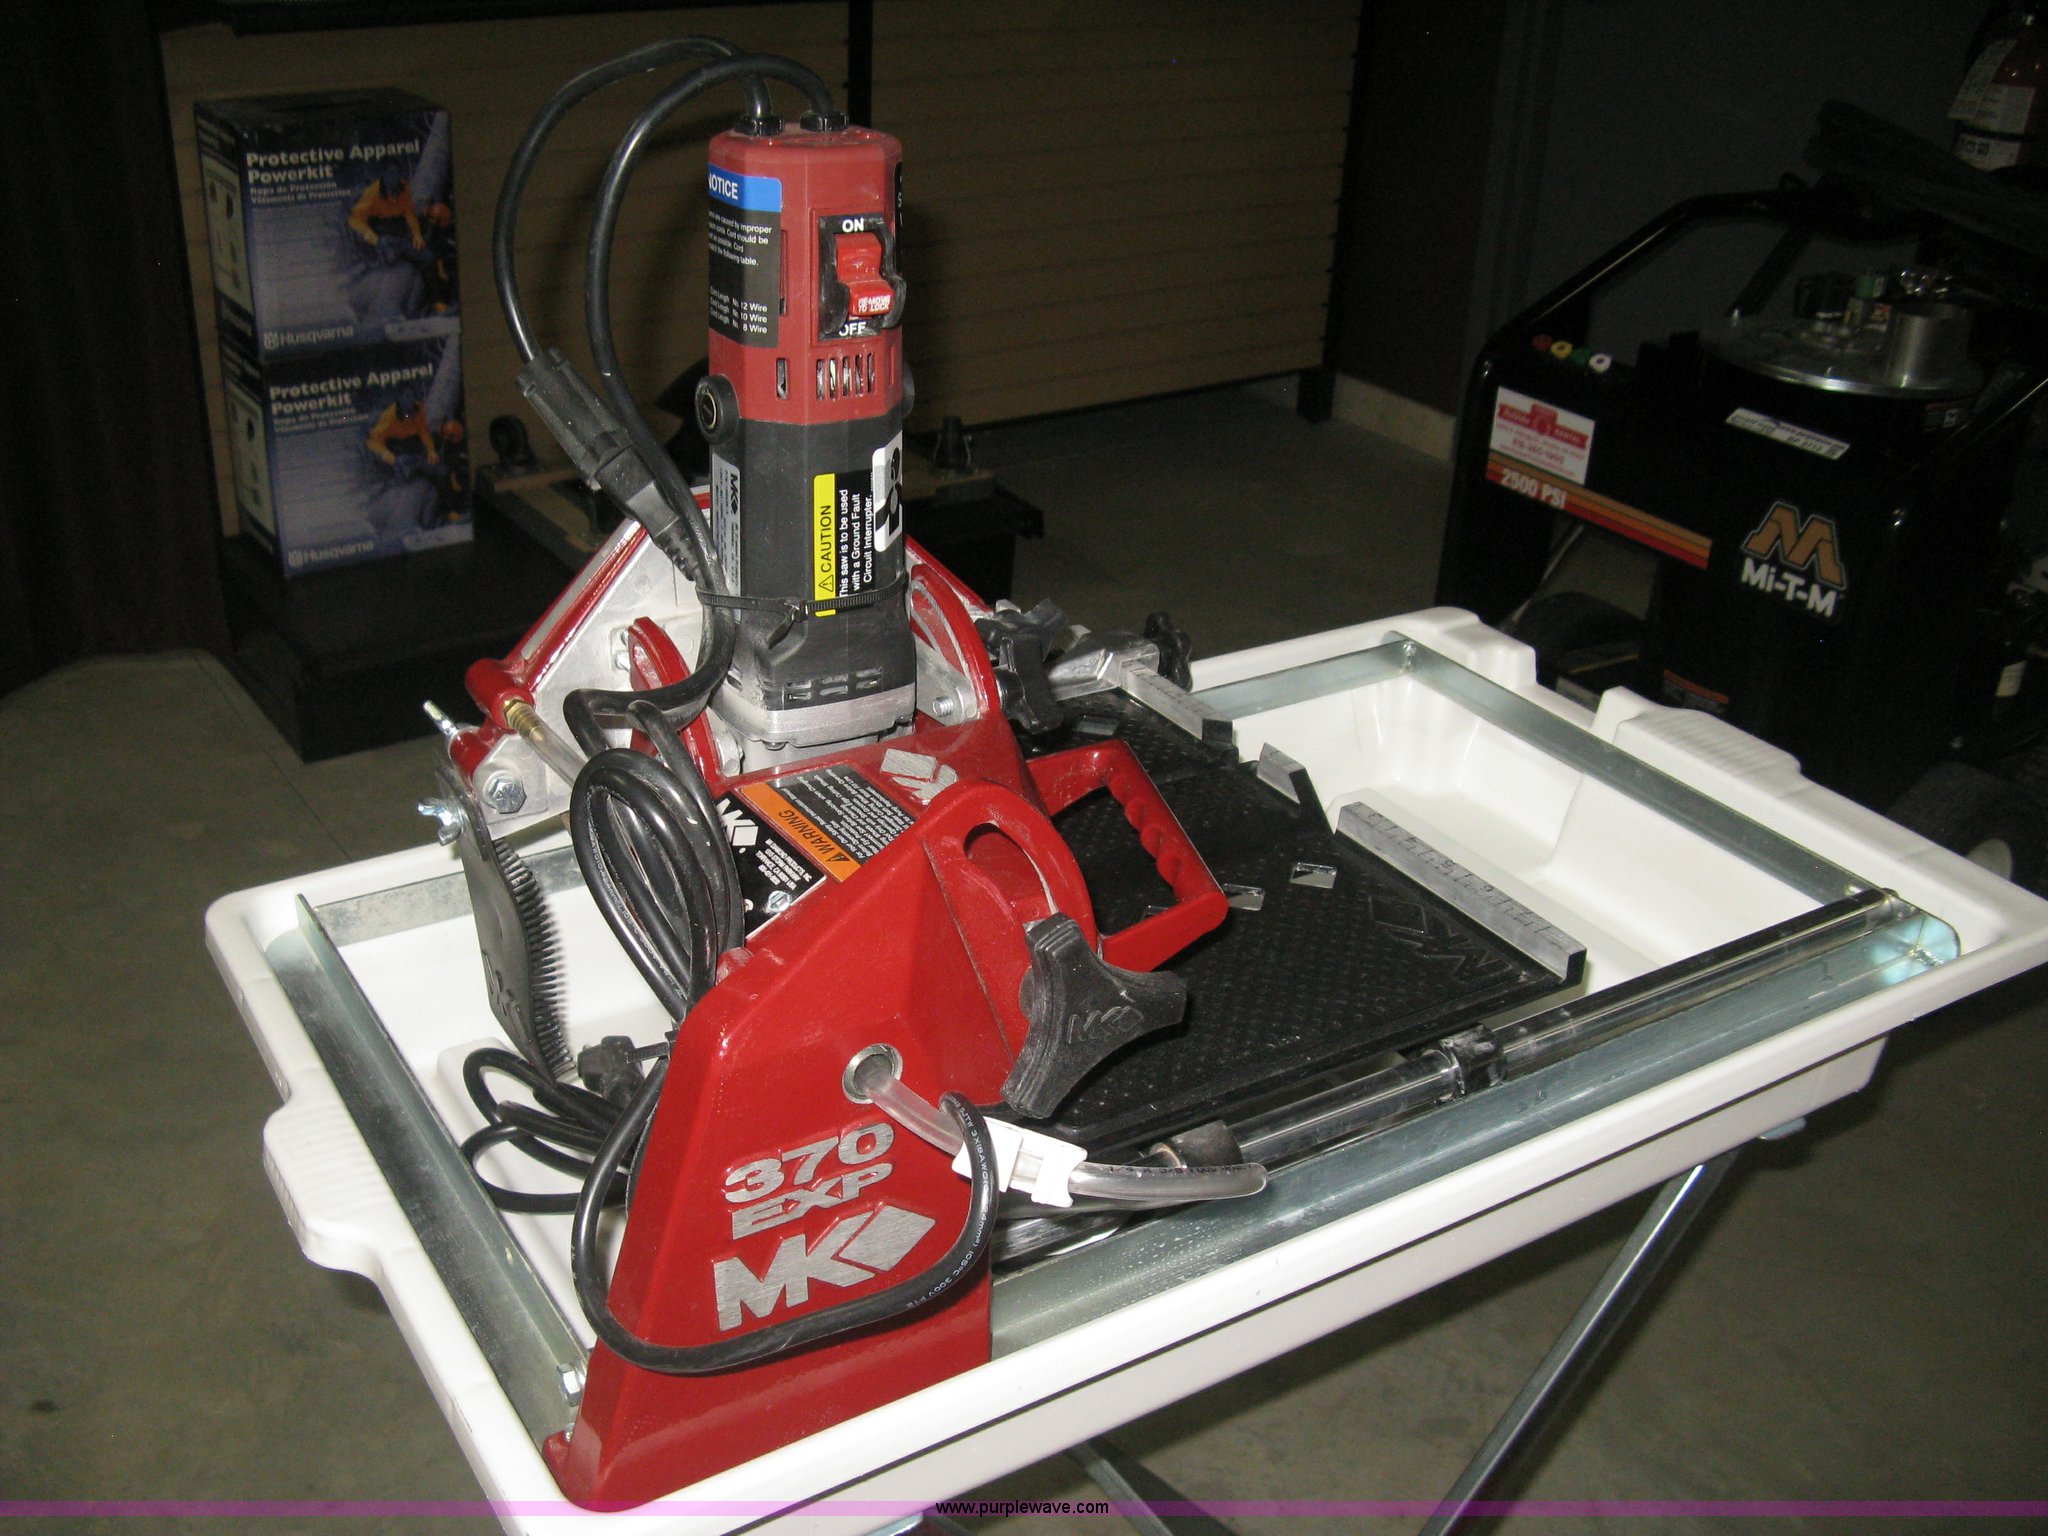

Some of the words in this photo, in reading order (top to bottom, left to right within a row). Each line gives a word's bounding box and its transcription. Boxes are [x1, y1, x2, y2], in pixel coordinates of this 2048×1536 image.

[247, 148, 344, 168] Protective
[350, 139, 420, 162] Apparel
[248, 164, 333, 184] Powerkit
[842, 218, 865, 233] ON
[758, 236, 769, 245] be
[750, 302, 768, 313] Wire
[750, 313, 768, 323] Wire
[743, 323, 748, 332] 8
[750, 323, 768, 334] Wire
[839, 321, 866, 337] OFF
[270, 375, 362, 400] Protective
[367, 362, 434, 387] Apparel
[272, 394, 352, 415] Powerkit
[839, 489, 848, 514] used
[851, 493, 860, 519] Fault
[839, 516, 848, 530] be
[863, 494, 874, 548] Interrupter.
[820, 505, 831, 573] CAUTION
[839, 532, 849, 542] to
[851, 521, 860, 559] Ground
[839, 544, 849, 553] is
[840, 556, 849, 576] saw
[863, 550, 873, 583] Circuit
[838, 577, 849, 598] This
[852, 570, 861, 591] with
[1742, 557, 1837, 617] Mi-T-M
[779, 809, 837, 855] WARNING
[725, 1122, 895, 1202] 370
[731, 1163, 893, 1240] EXP
[713, 1210, 876, 1332] MK
